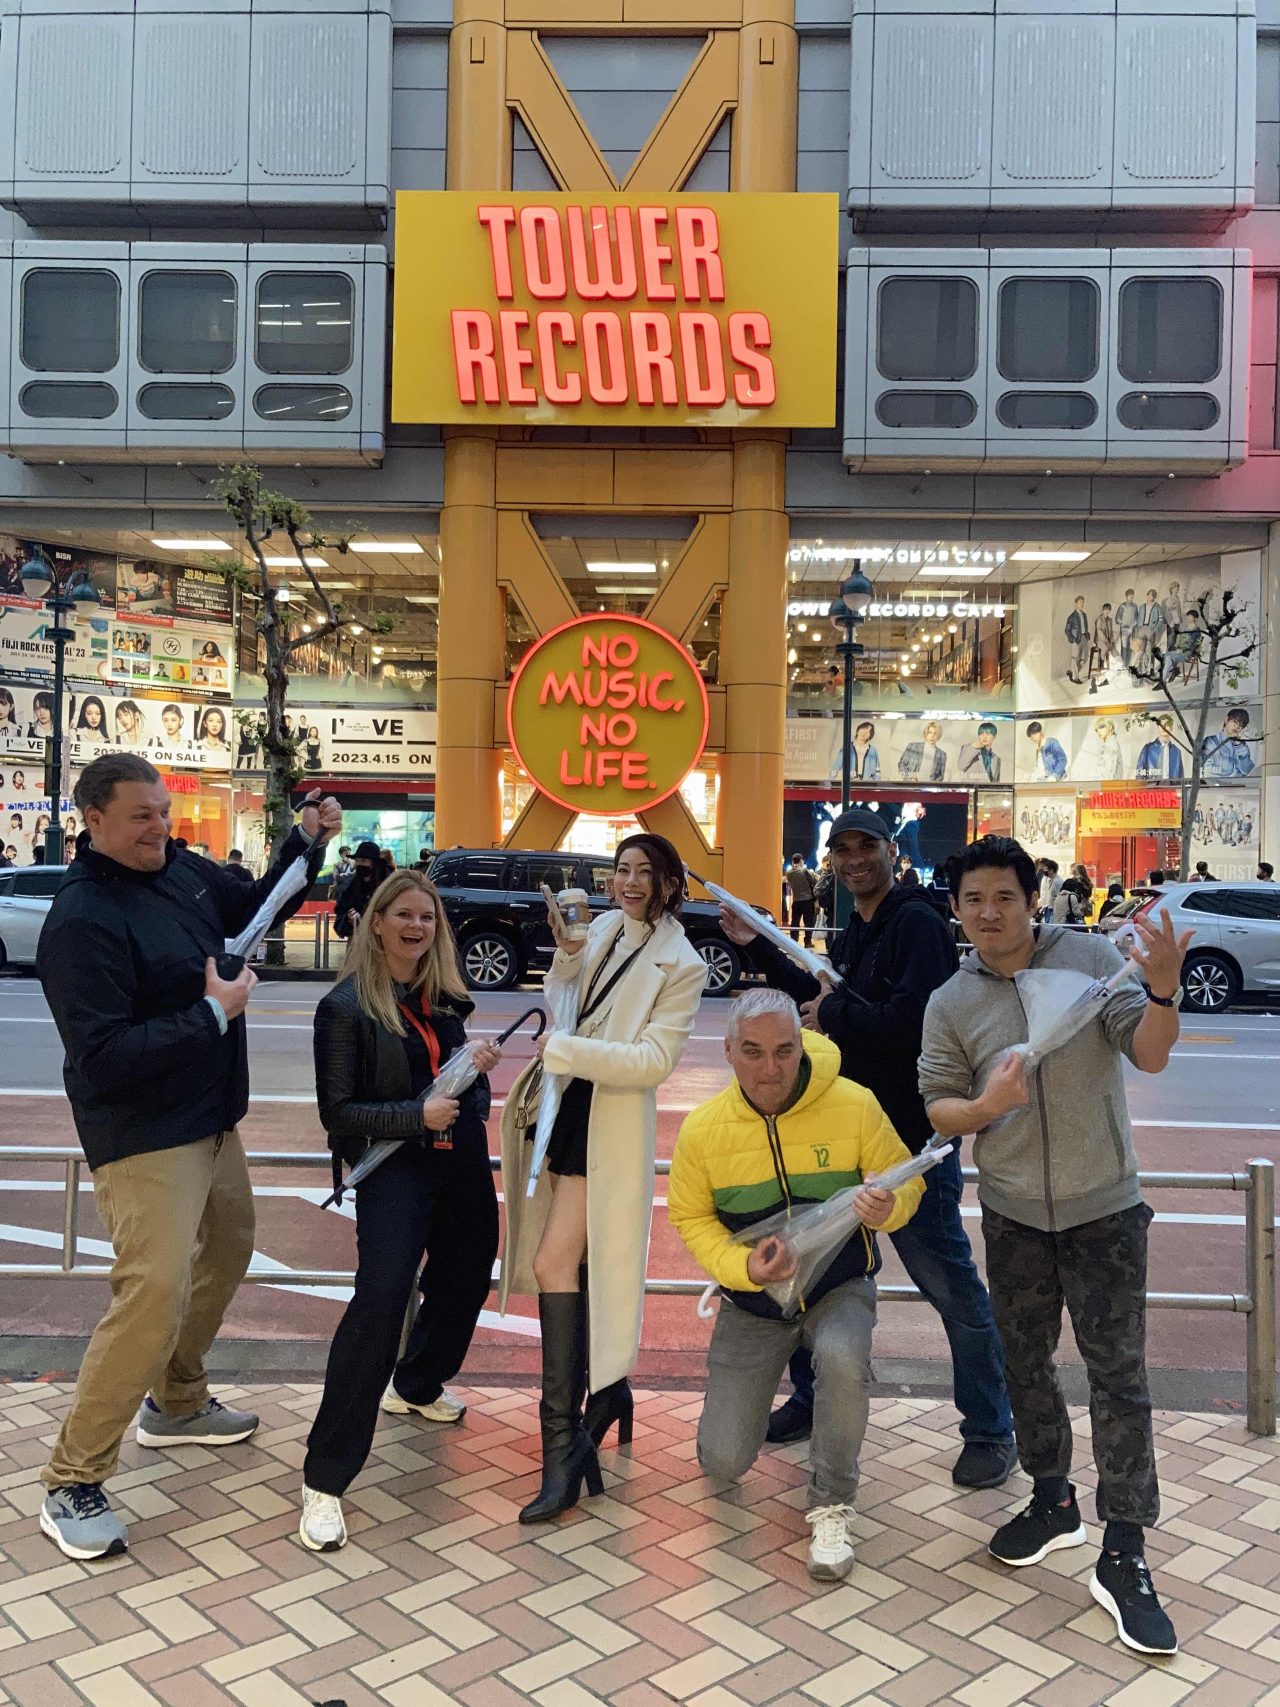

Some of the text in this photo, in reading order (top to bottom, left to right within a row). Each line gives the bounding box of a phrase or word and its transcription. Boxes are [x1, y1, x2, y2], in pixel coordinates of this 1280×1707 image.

[477, 205, 725, 302] TOWER
[450, 309, 777, 407] RECORDS
[2, 639, 19, 650] FUJI
[20, 641, 40, 653] ROCK
[41, 644, 73, 656] FESAL
[581, 633, 640, 668] NO
[539, 670, 686, 712] MUSIC,
[579, 712, 638, 747] NO
[155, 751, 172, 761] ON
[176, 752, 207, 763] SALE
[331, 752, 432, 765] 2023.4.15 ON
[559, 749, 657, 790] LIFE.
[1090, 791, 1180, 808] TOWER RECORDS
[813, 1147, 830, 1168] 12
